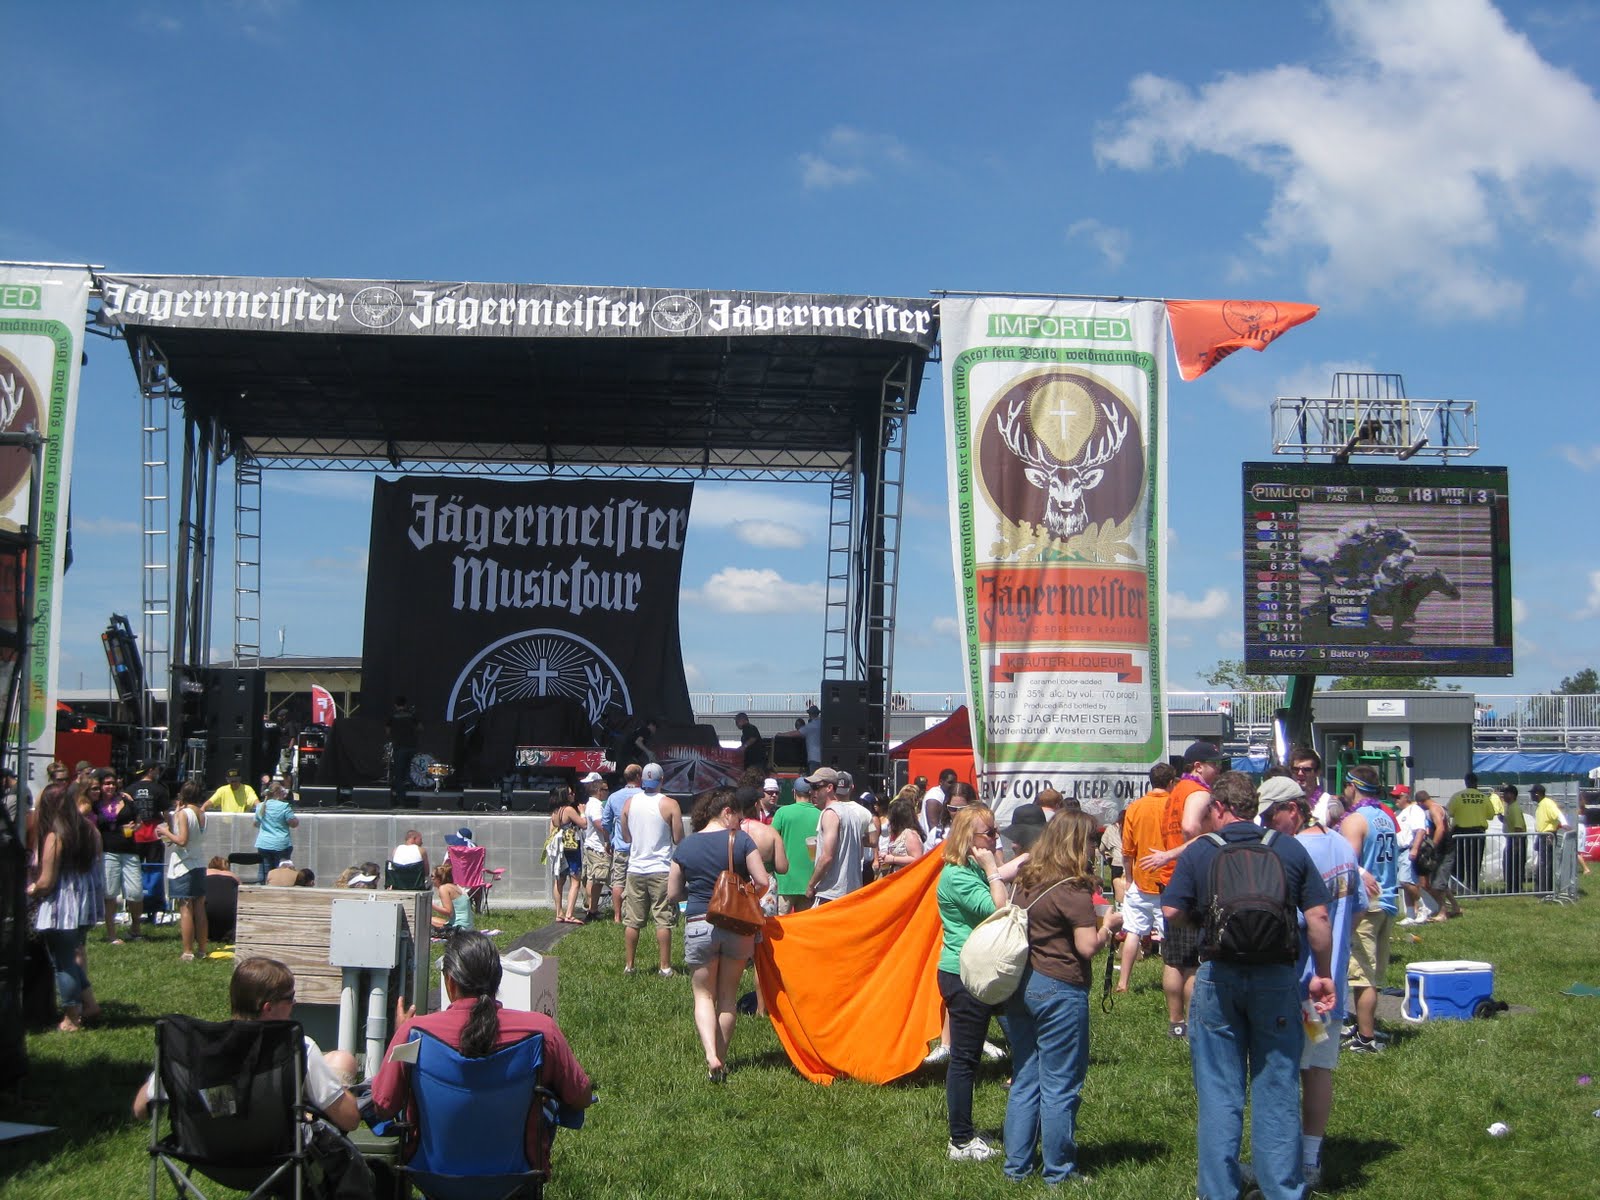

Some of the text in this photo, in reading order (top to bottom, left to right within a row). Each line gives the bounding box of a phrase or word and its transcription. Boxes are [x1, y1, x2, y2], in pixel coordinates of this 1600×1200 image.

[994, 315, 1126, 338] IMPORTED
[964, 347, 989, 365] hegt
[992, 347, 1015, 359] sein
[956, 365, 967, 390] und
[959, 453, 968, 466] er
[45, 482, 59, 504] den
[1255, 487, 1311, 498] PIMLICO
[1326, 486, 1349, 494] TRACK
[1412, 487, 1433, 502] 18
[1441, 487, 1466, 497] MTR
[1374, 495, 1399, 503] GOOD
[1477, 489, 1488, 503] 3
[1281, 512, 1295, 520] 17
[1281, 532, 1295, 540] 18
[1281, 562, 1295, 570] 23
[981, 574, 1145, 632] Jägermeister
[1330, 595, 1355, 605] Race
[1265, 603, 1278, 611] 10
[1283, 623, 1296, 631] 17
[1266, 633, 1296, 641] 13 11
[968, 643, 979, 666] des
[1269, 649, 1297, 658] RACE
[1358, 649, 1369, 660] Up
[989, 690, 1018, 699] 750 ml
[1027, 690, 1044, 698] 35%
[1067, 689, 1077, 699] by
[1079, 689, 1094, 698] vol.
[1102, 690, 1114, 699] (70
[1024, 702, 1057, 710] Produced
[1124, 716, 1137, 724] AG
[1099, 728, 1138, 736] Germany
[982, 780, 1007, 800] RVE
[1073, 780, 1109, 799] KEEP
[1113, 779, 1134, 799] ON
[1376, 832, 1394, 863] 23
